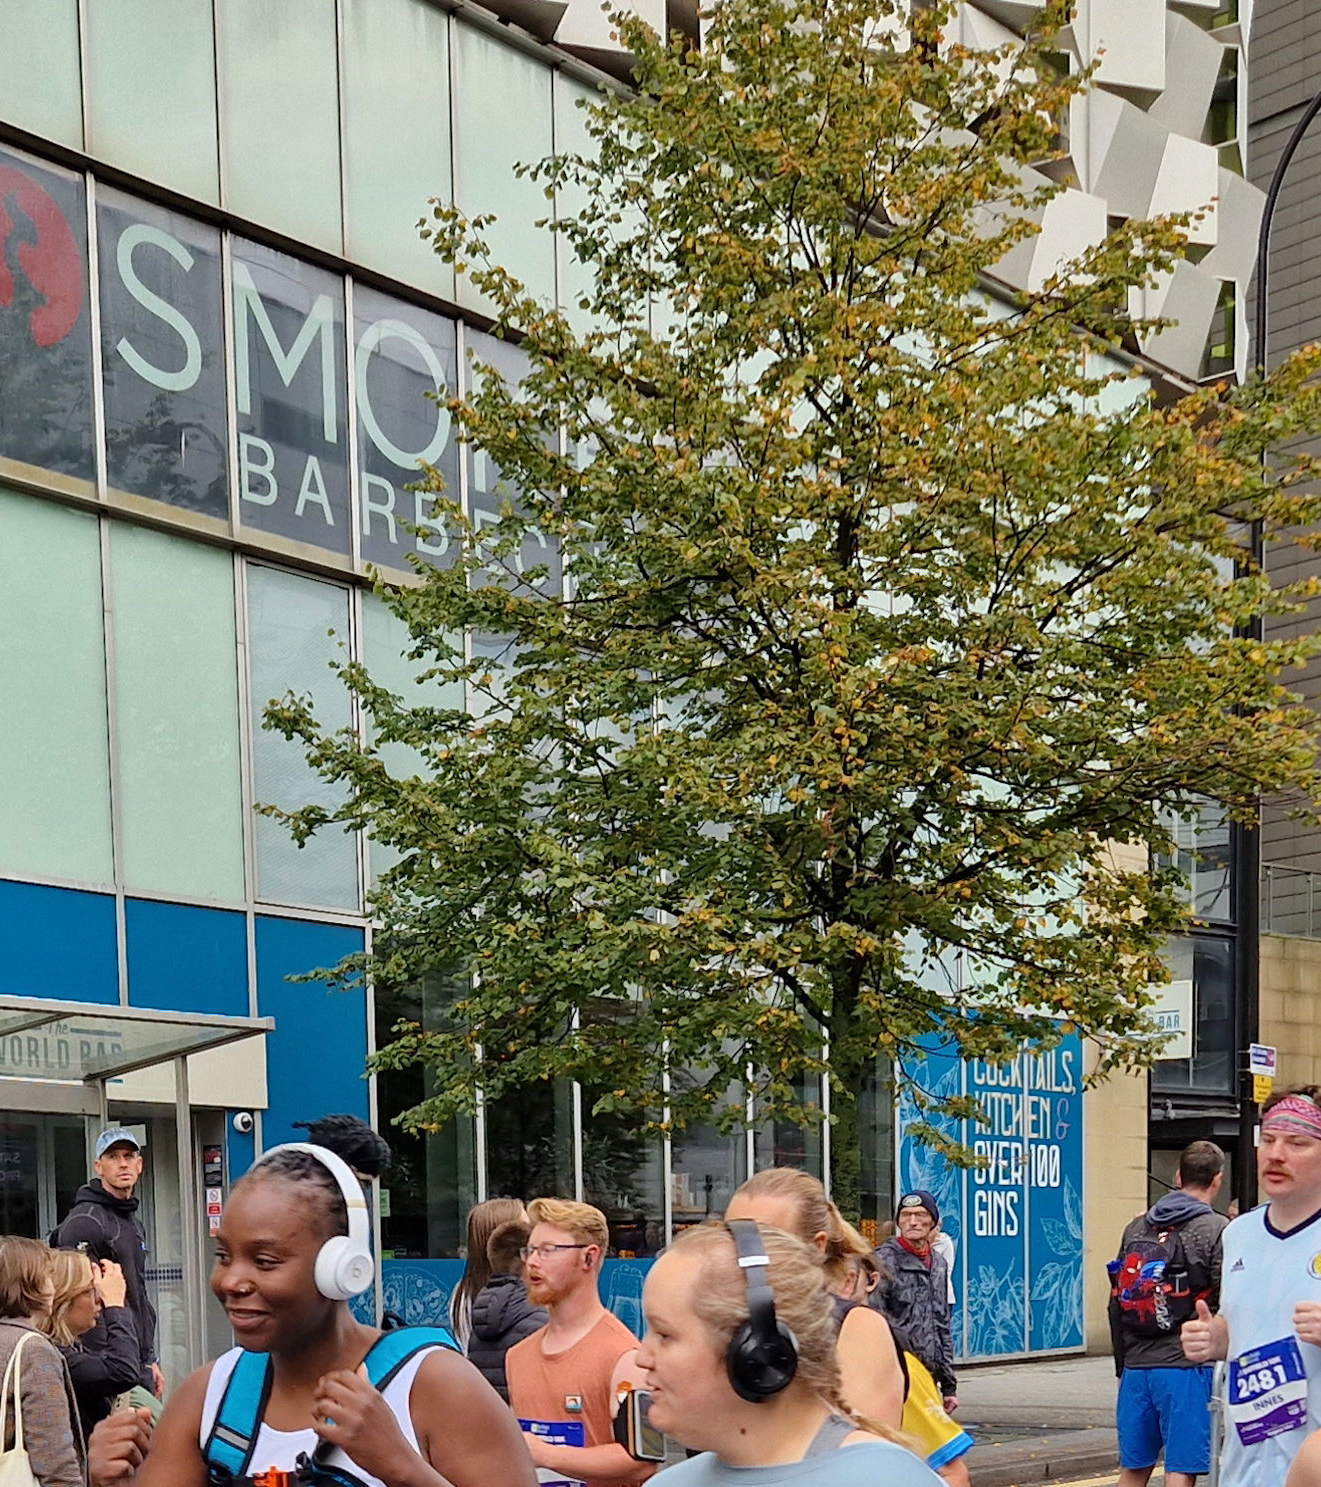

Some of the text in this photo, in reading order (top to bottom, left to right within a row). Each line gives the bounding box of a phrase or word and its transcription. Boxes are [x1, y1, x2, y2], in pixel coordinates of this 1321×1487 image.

[974, 1091, 1071, 1140] KITCHEN &
[974, 1140, 1061, 1188] OVER 100
[974, 1190, 1019, 1237] GINS
[1237, 1364, 1287, 1399] 2481
[1253, 1394, 1284, 1411] INNES
